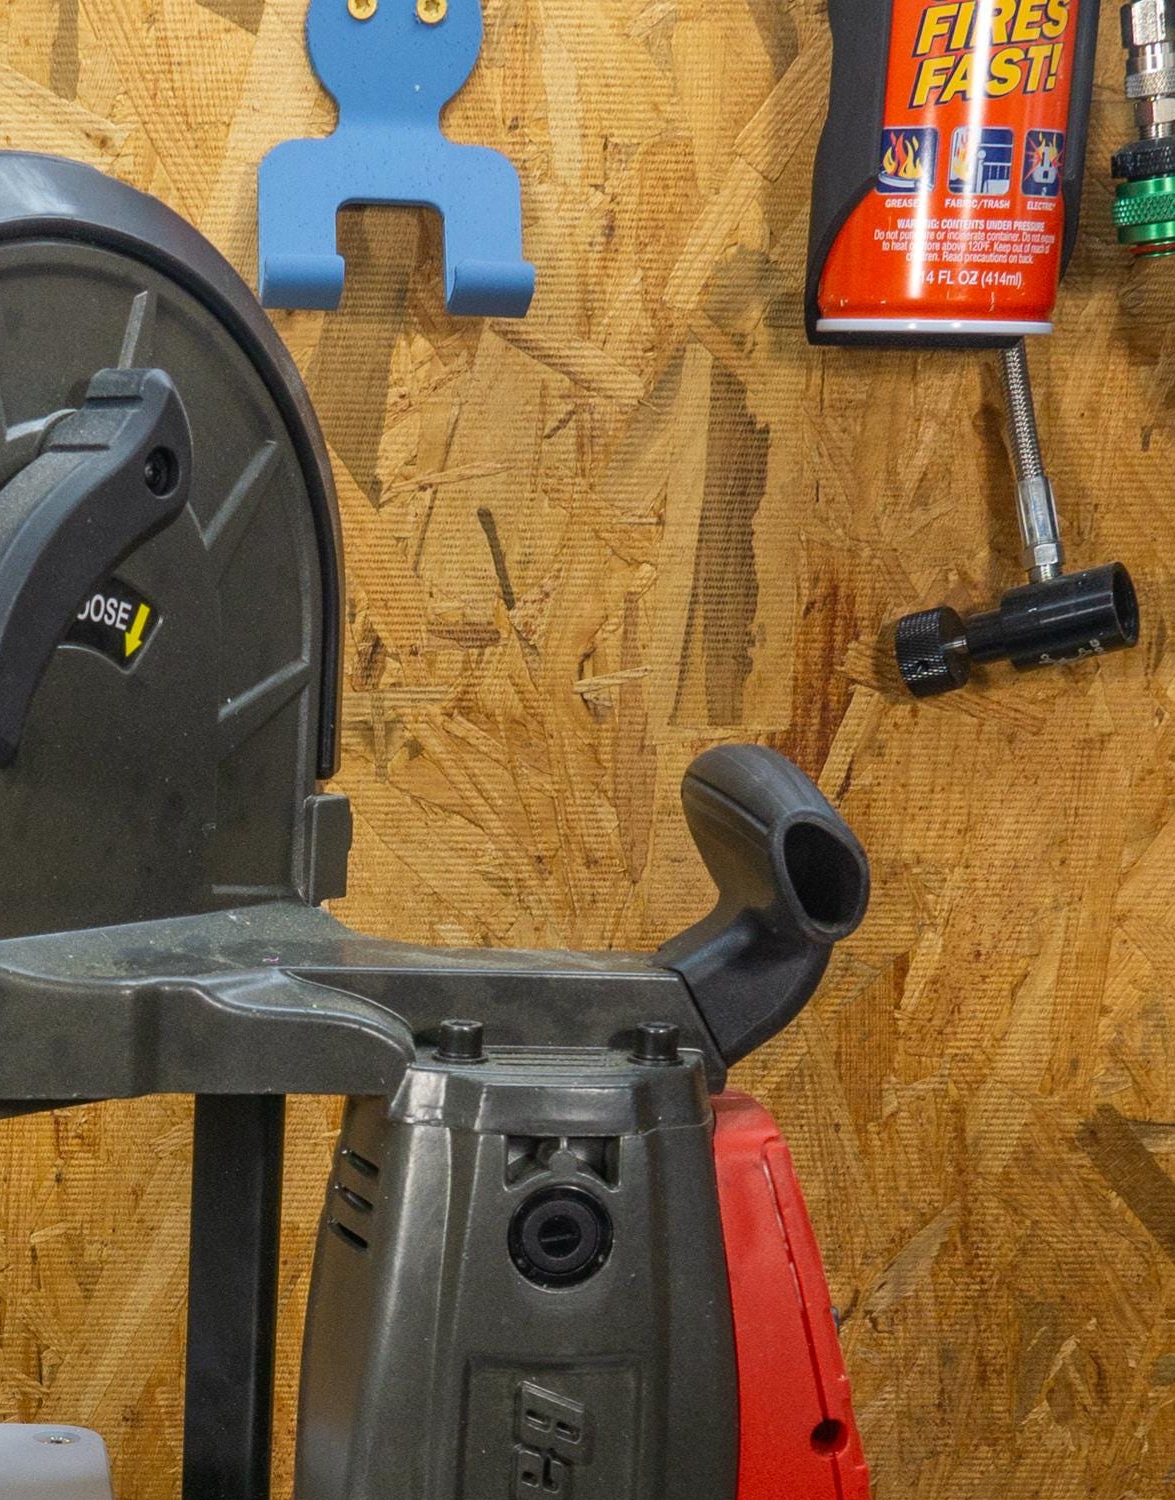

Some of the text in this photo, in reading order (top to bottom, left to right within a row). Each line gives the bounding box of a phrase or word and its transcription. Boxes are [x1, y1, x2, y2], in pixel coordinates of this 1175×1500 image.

[912, 0, 1070, 57] FIRES
[908, 42, 1063, 109] FAST!
[941, 219, 1045, 231] CONTENTS UNDER PRESSURE
[874, 229, 885, 240] Do
[887, 230, 898, 239] not
[882, 242, 890, 250] to
[891, 241, 907, 250] heat
[942, 241, 966, 251] above
[994, 242, 1012, 253] Keep
[943, 252, 1018, 263] Read precautions on
[938, 270, 954, 285] FL
[958, 271, 978, 285] OZ
[981, 271, 1022, 287] (414ml)
